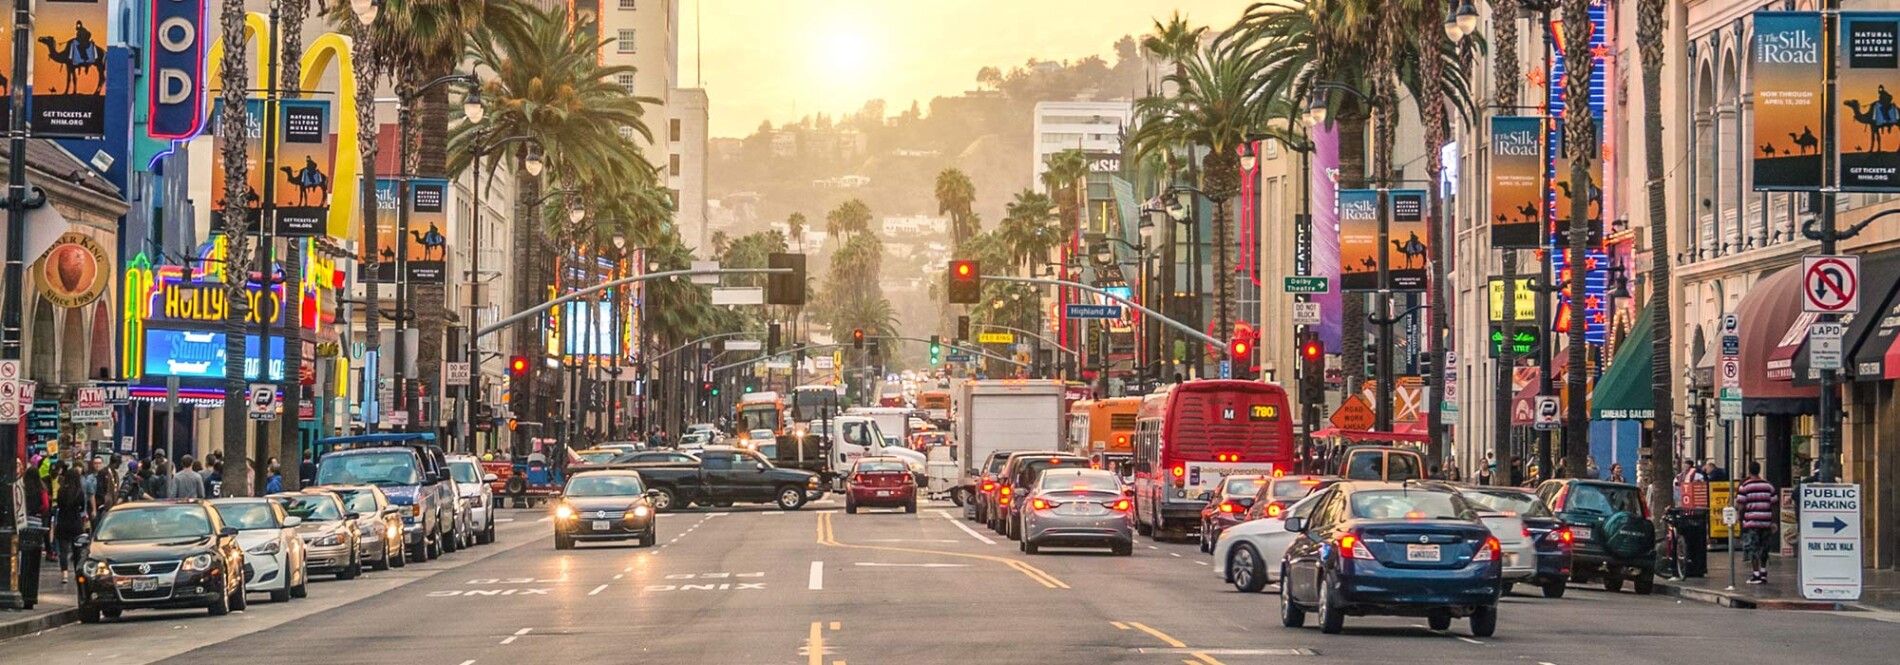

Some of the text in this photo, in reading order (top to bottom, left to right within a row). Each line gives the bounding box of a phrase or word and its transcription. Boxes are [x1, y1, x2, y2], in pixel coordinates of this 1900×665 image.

[1764, 30, 1813, 50] The Silk
[159, 0, 195, 104] OD
[1765, 43, 1818, 63] Road
[1510, 131, 1534, 145] Silk
[1500, 140, 1538, 156] Road
[1354, 200, 1374, 212] Silk
[1345, 207, 1376, 220] Road
[80, 236, 104, 263] KING
[45, 289, 95, 306] Since 1989
[166, 284, 280, 323] HOLLYOOD
[1071, 307, 1118, 317] Highland Av
[1812, 326, 1840, 335] LAPD
[80, 389, 104, 402] ATM
[73, 410, 109, 418] INTERNET
[1224, 408, 1235, 420] M
[1254, 406, 1274, 418] 780
[1601, 409, 1628, 419] CAMERAS
[1199, 466, 1232, 474] Unlimited
[213, 485, 221, 496] 5
[1804, 489, 1856, 498] PUBLIC
[1803, 501, 1857, 510] PARKING
[1808, 542, 1854, 551] PARK LOCK WALK
